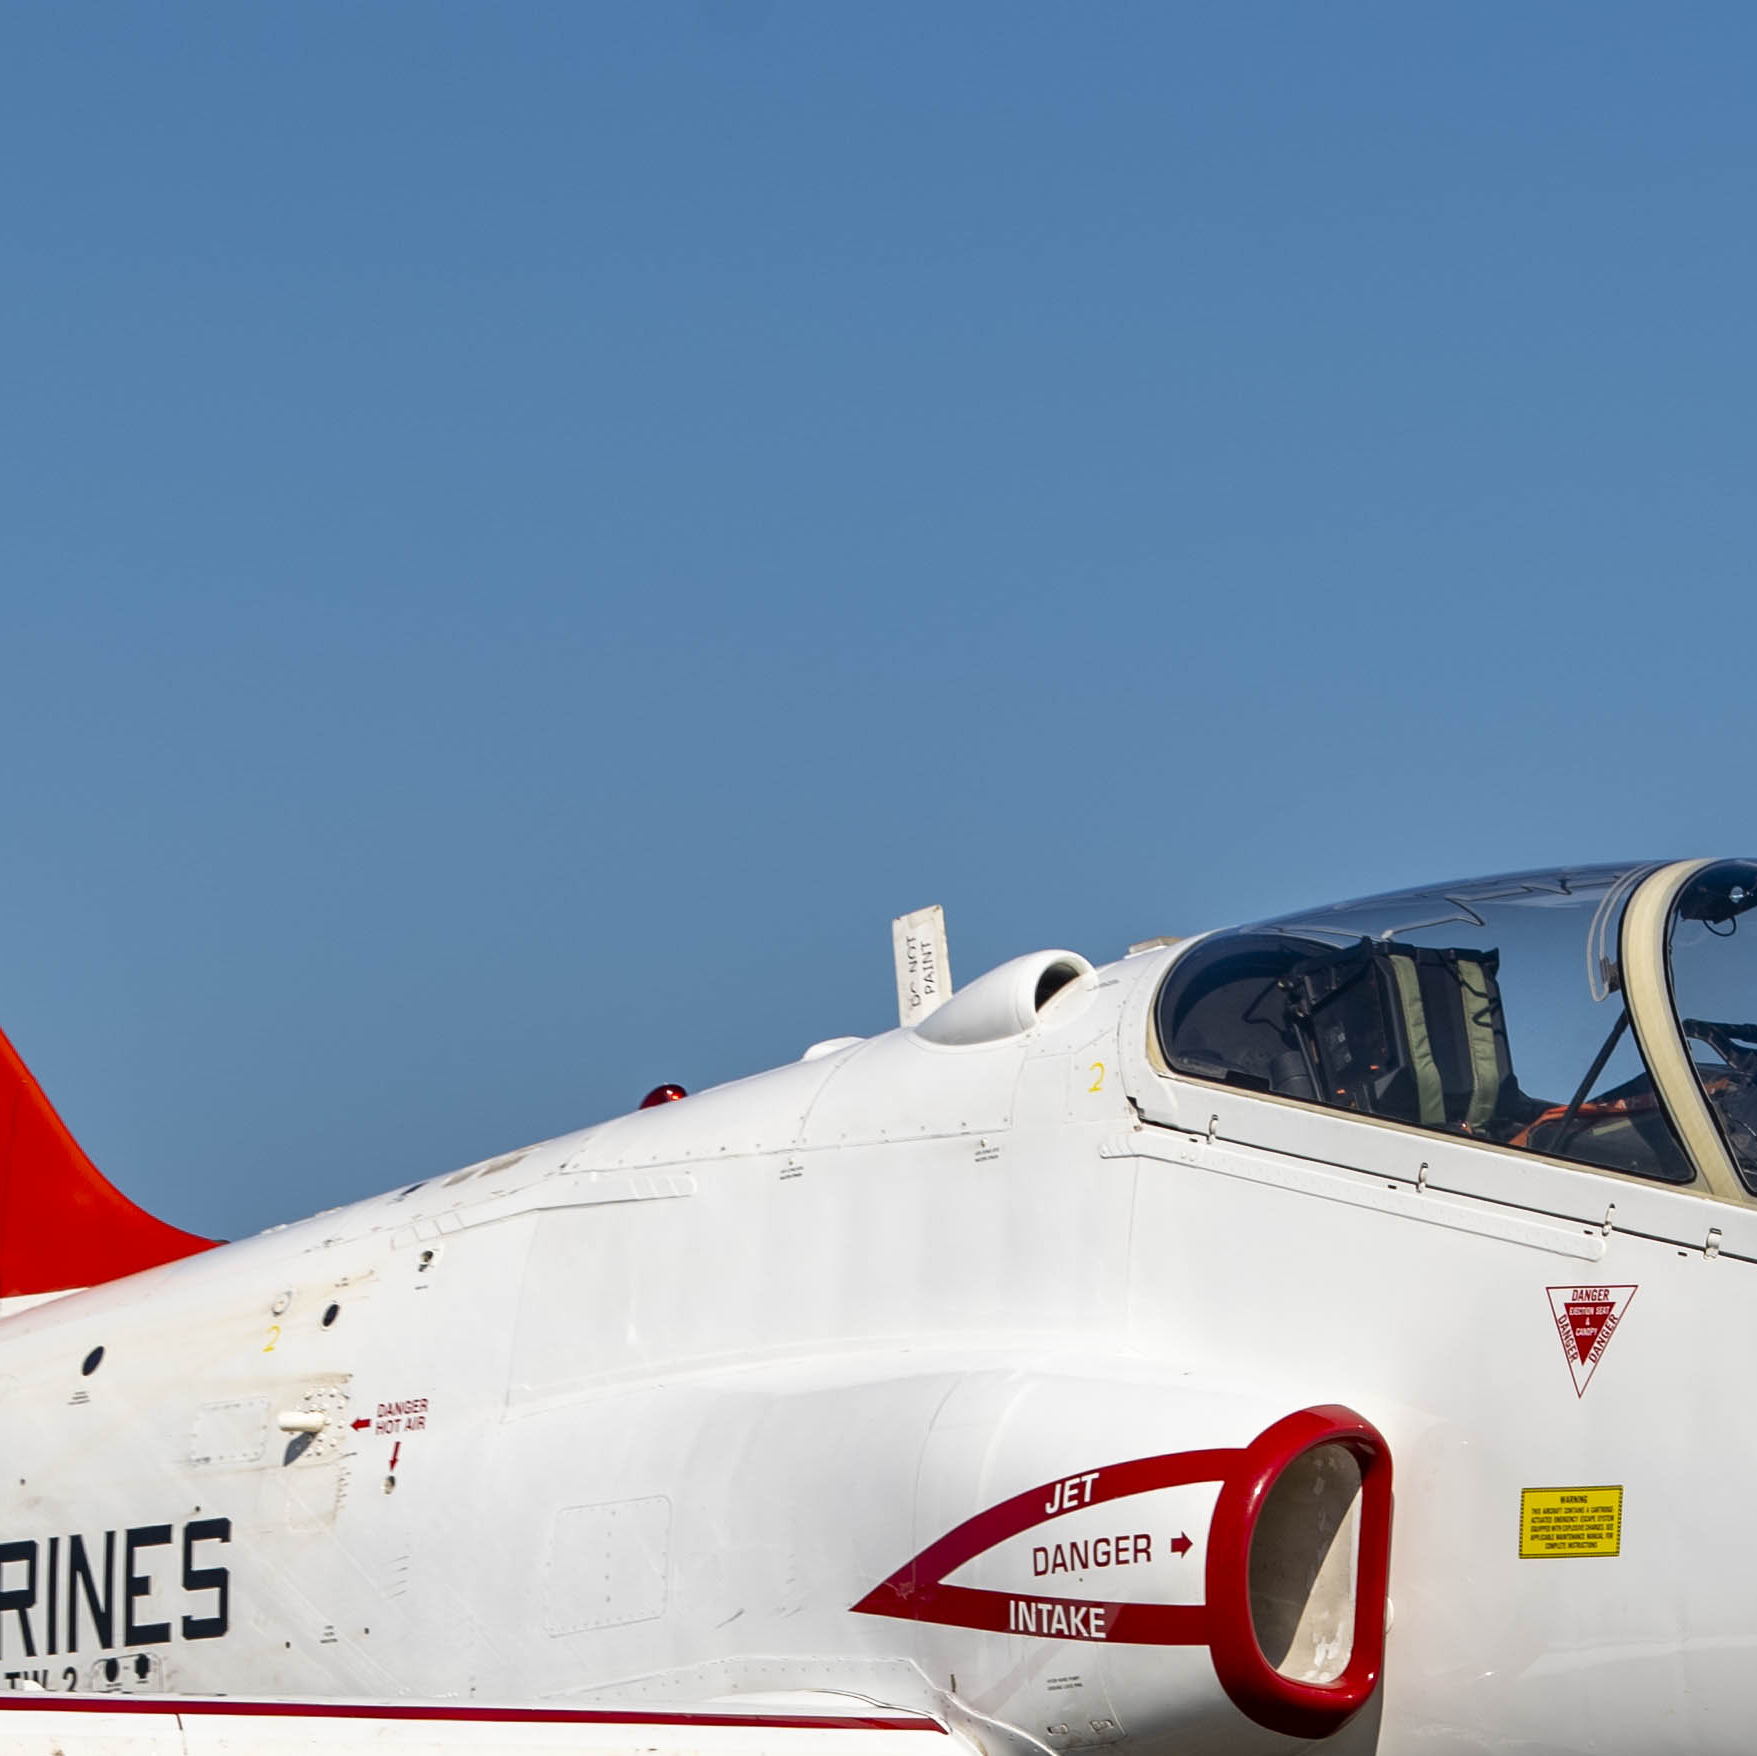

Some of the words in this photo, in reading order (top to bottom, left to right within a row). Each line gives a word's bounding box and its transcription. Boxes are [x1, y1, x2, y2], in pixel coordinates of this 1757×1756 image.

[906, 936, 919, 974] NOT
[920, 941, 936, 996] PAINT
[1087, 1061, 1106, 1093] 2
[1572, 1289, 1610, 1302] DANGER
[262, 1324, 282, 1353] 2
[1557, 1313, 1579, 1364] DANGER
[1588, 1313, 1619, 1364] DANGER
[374, 1418, 402, 1436] HOT
[403, 1415, 427, 1432] AIR
[376, 1398, 429, 1418] DANGER
[1044, 1472, 1100, 1516] JET
[1560, 1495, 1588, 1504] WARNING
[1032, 1532, 1153, 1578] DANGER
[1009, 1599, 1107, 1639] INTAKE
